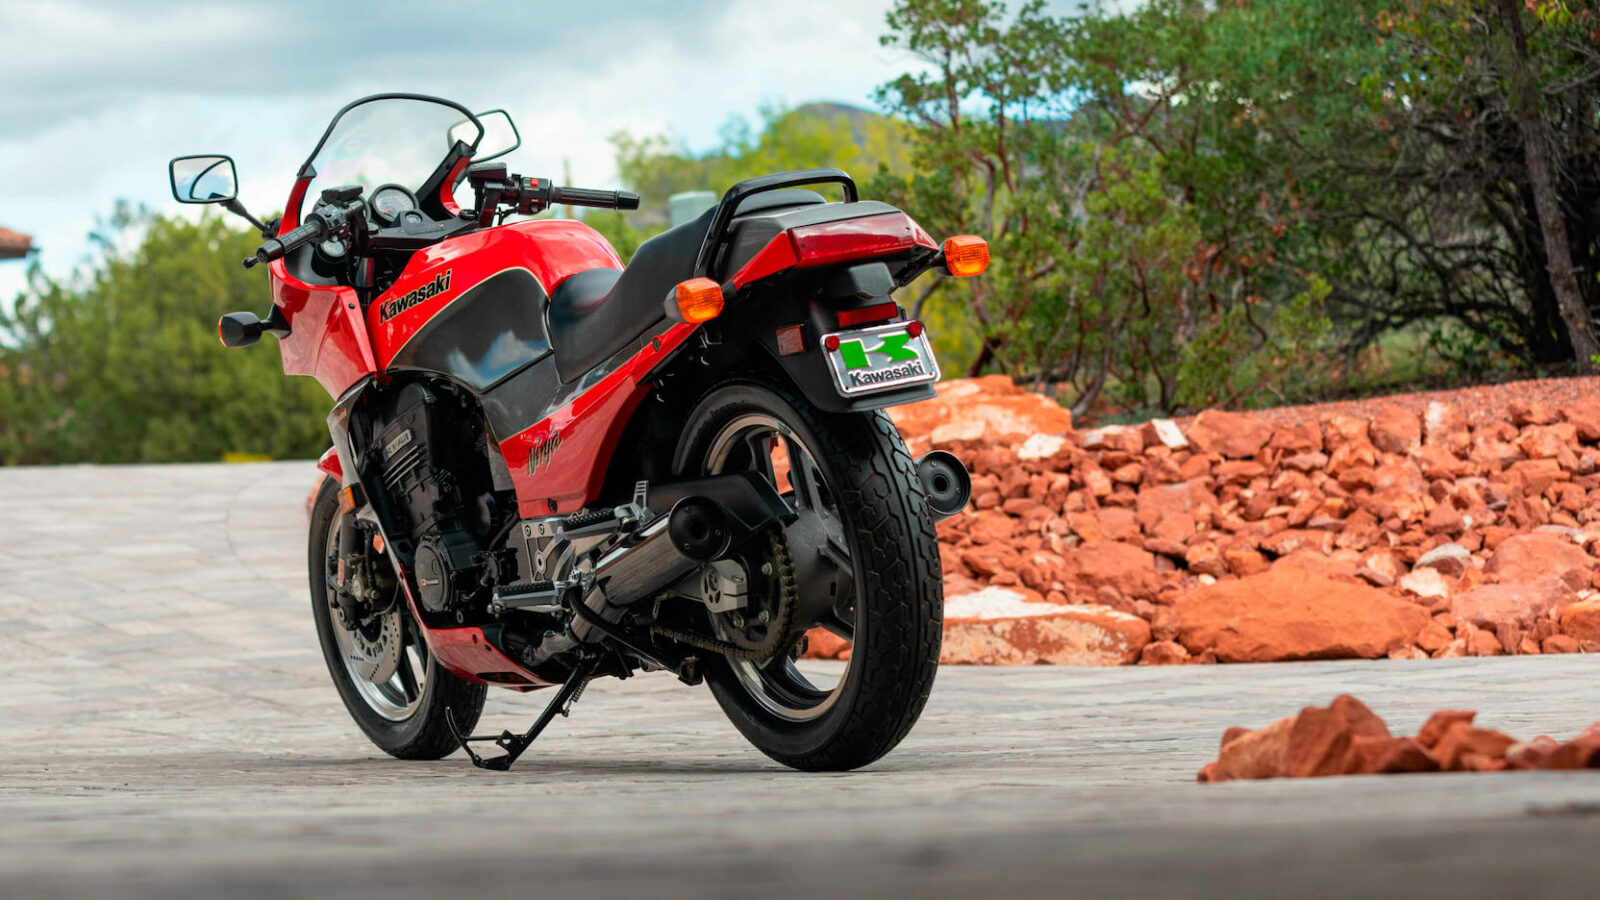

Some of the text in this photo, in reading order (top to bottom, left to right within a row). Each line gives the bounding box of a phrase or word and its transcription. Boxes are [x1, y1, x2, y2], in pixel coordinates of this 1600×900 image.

[380, 269, 452, 325] Kawasaki
[848, 361, 924, 386] Kawasaki
[526, 428, 563, 477] Ninja
